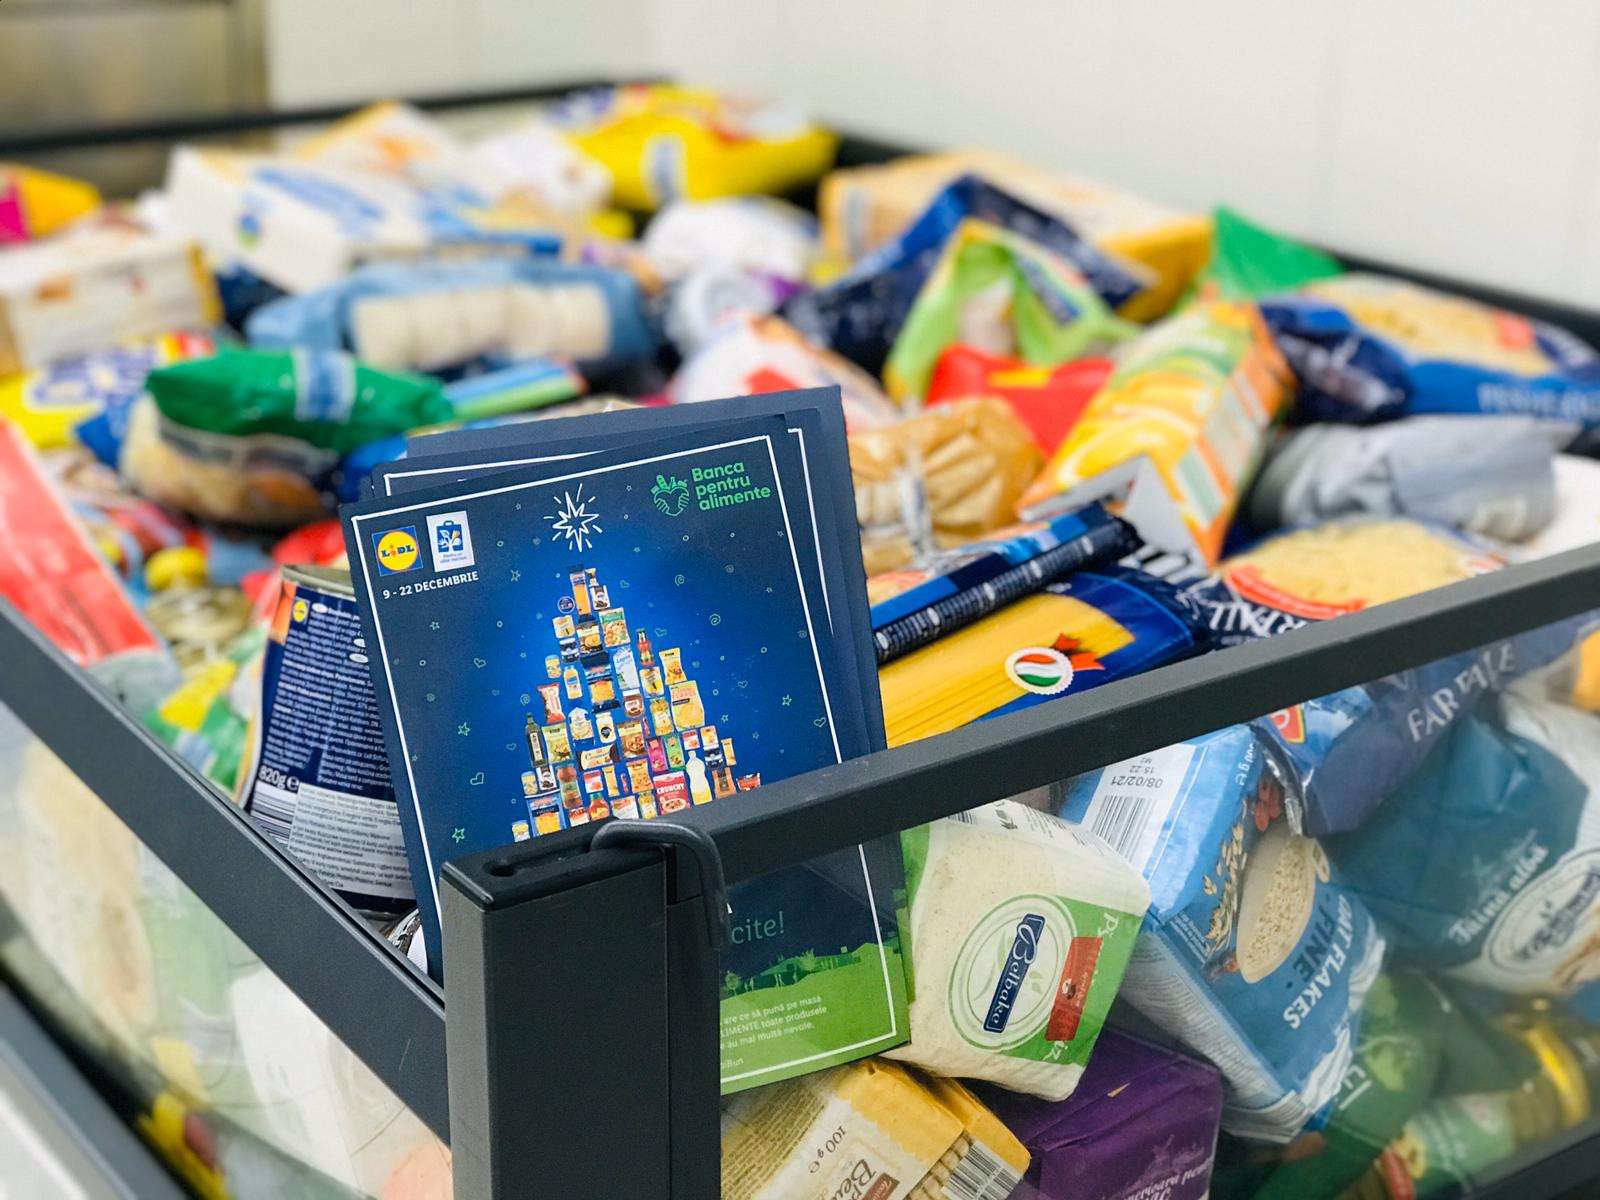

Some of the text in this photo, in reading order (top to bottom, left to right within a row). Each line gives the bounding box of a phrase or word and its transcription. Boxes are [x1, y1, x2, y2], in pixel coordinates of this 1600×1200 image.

[691, 462, 745, 482] Banca
[695, 476, 751, 500] pentru
[699, 486, 771, 511] alimente
[381, 544, 415, 558] LIDL
[383, 589, 390, 599] 9
[399, 585, 413, 596] 22
[414, 571, 479, 593] DECEMBRIE
[656, 783, 685, 795] CRUNCHY
[1111, 776, 1164, 789] 08/02/21
[731, 911, 785, 944] cite!
[1293, 904, 1337, 983] FINE
[991, 923, 1038, 1026] Belbake
[1283, 942, 1347, 1030] FLAKES
[761, 1017, 784, 1028] toate
[785, 1006, 828, 1023] produsele
[786, 1002, 798, 1011] pe
[825, 1126, 846, 1153] 100
